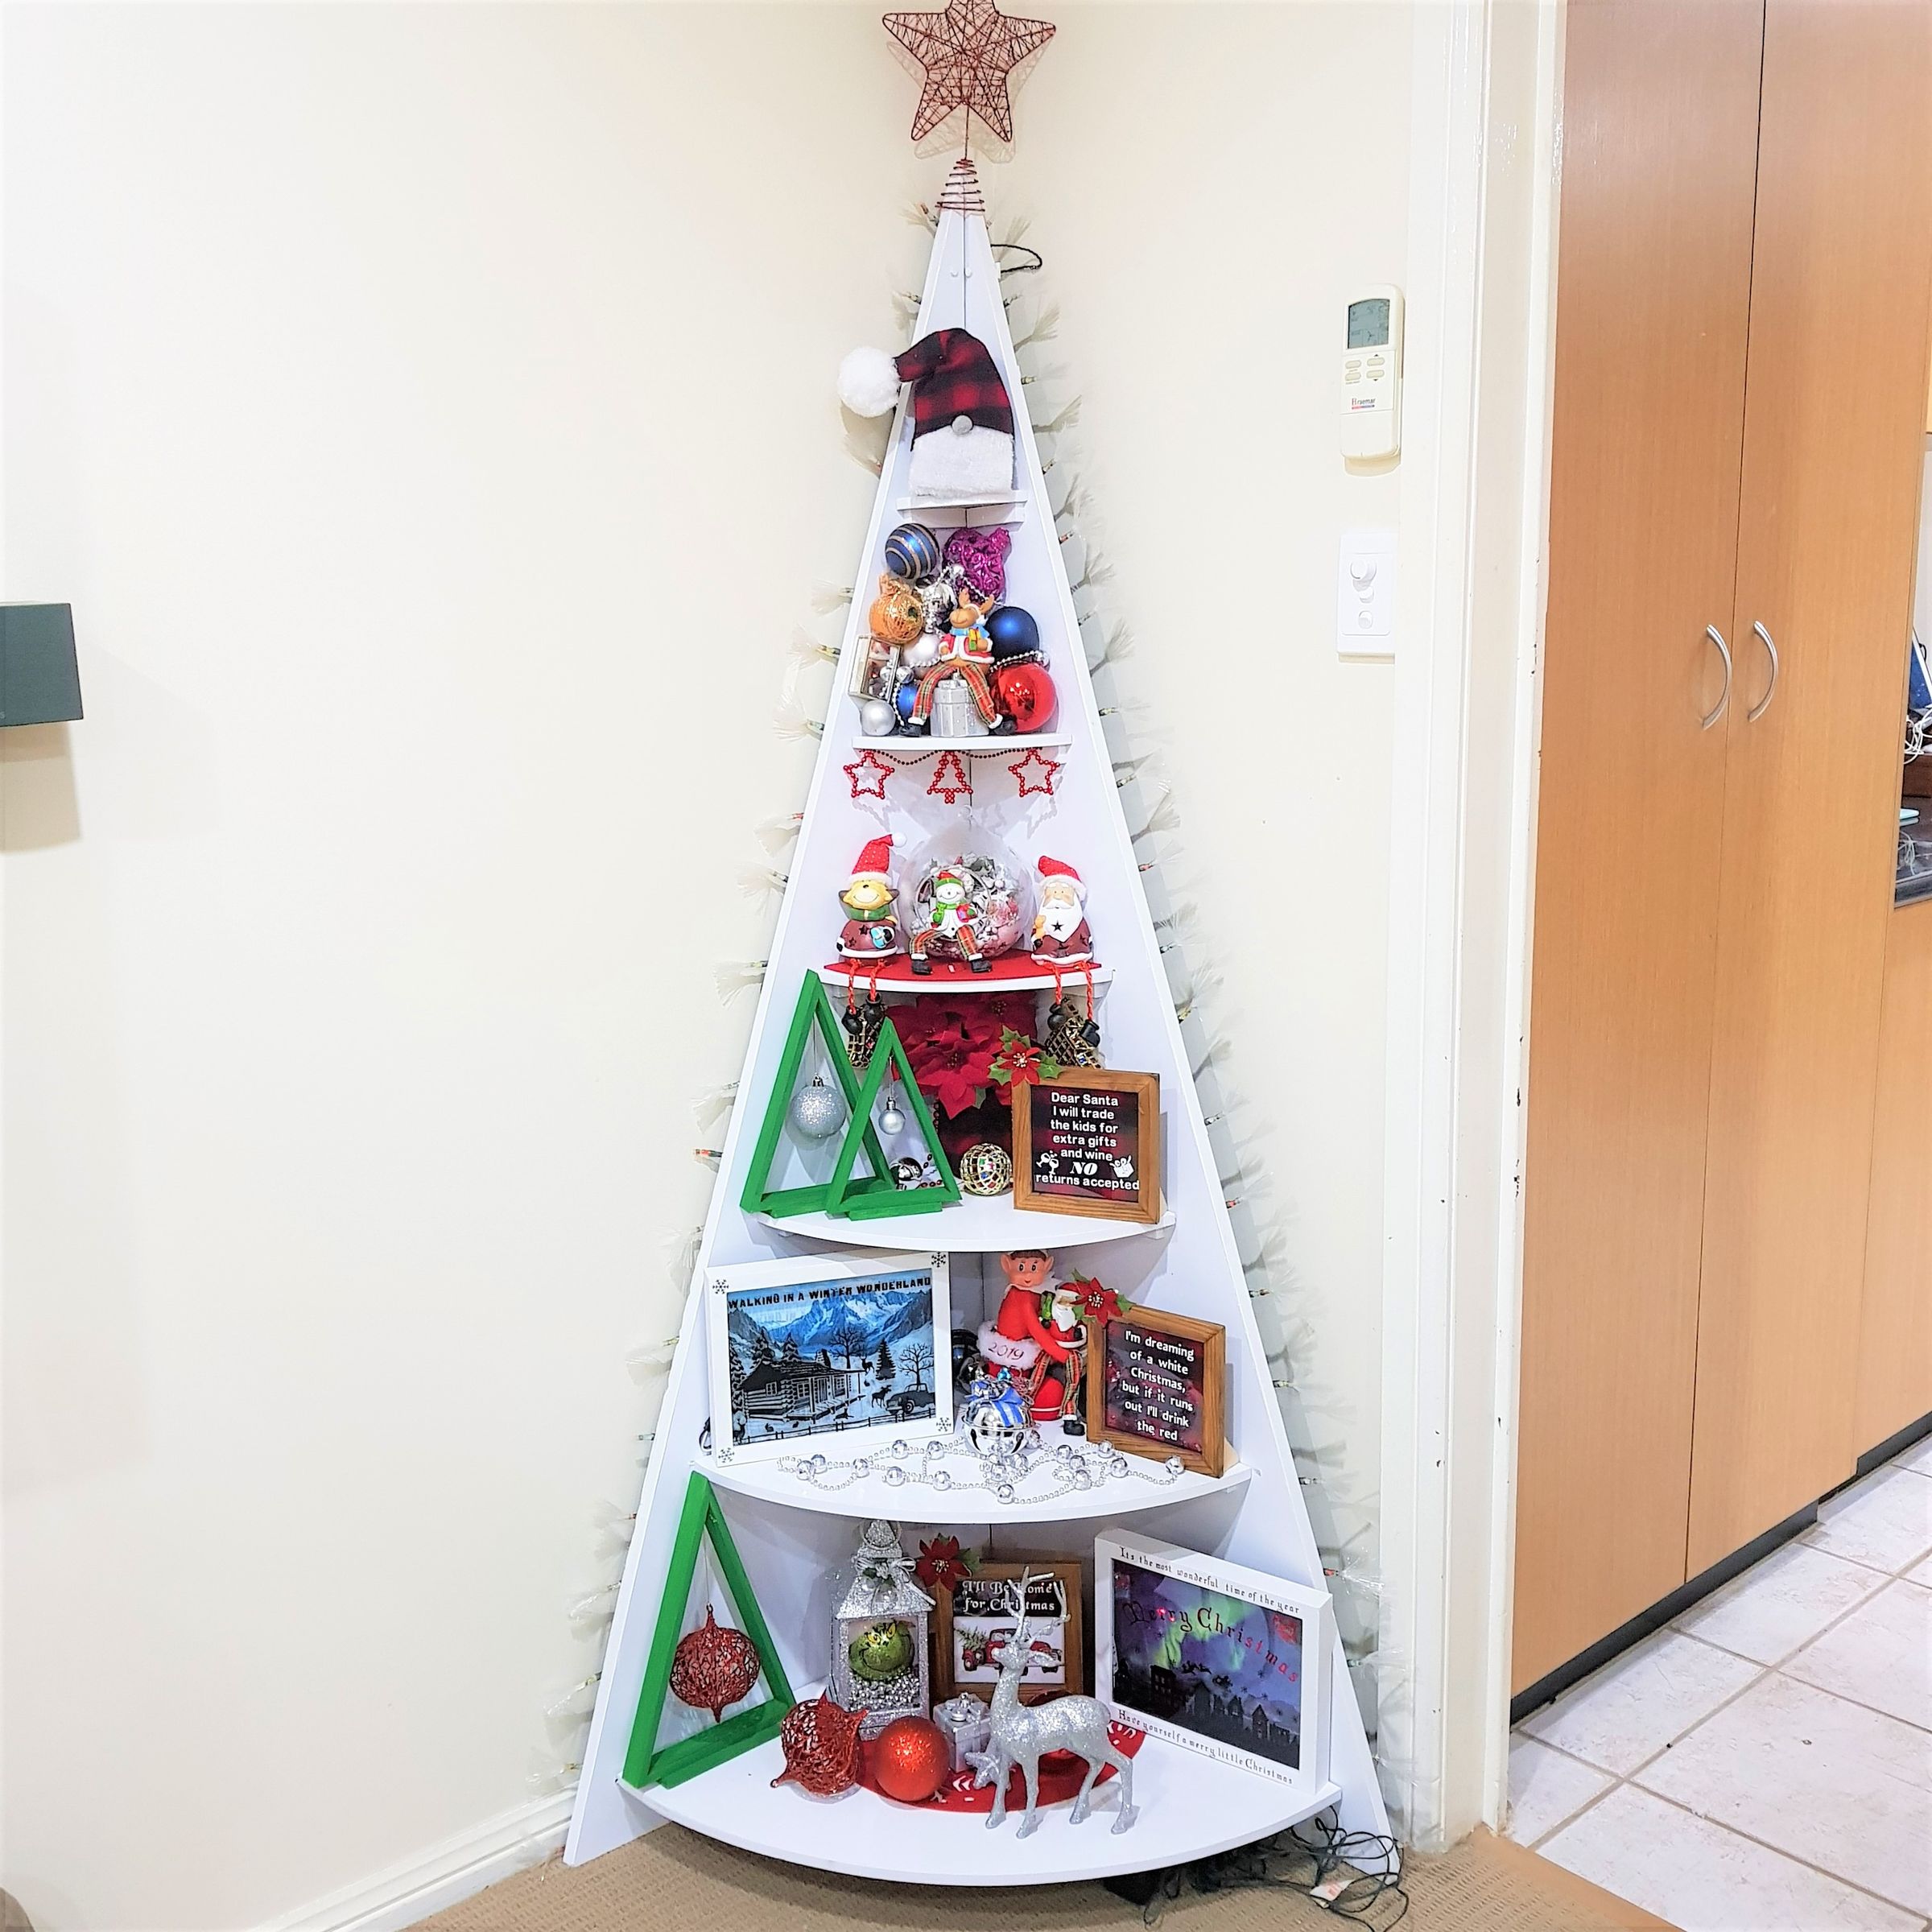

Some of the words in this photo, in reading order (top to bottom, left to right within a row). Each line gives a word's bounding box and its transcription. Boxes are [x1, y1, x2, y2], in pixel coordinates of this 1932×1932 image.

[1051, 1092, 1080, 1104] Dear
[1083, 1095, 1118, 1106] Santa
[1053, 1106, 1056, 1116] I
[1059, 1107, 1079, 1117] will
[1081, 1108, 1114, 1120] trade
[1051, 1120, 1070, 1130] the
[1072, 1121, 1096, 1132] kids
[1100, 1123, 1118, 1133] for
[1053, 1135, 1085, 1145] extra
[1088, 1136, 1117, 1148] gifts
[1060, 1148, 1083, 1159] and
[1085, 1150, 1113, 1161] wine
[1070, 1162, 1098, 1175] NO
[1036, 1174, 1080, 1185] returns
[1083, 1179, 1139, 1191] accepted
[728, 1293, 780, 1309] WALKING
[784, 1293, 795, 1302] IN
[798, 1292, 805, 1302] A
[809, 1286, 852, 1299] WINTER
[856, 1277, 931, 1293] WONDERLAND
[988, 1341, 1025, 1360] 2019
[1125, 1331, 1141, 1344] I'm
[1145, 1336, 1195, 1361] dreaming
[1130, 1351, 1141, 1361] of
[1146, 1356, 1153, 1364] a
[1158, 1360, 1188, 1375] white
[1131, 1368, 1186, 1393] Christmas,
[1122, 1381, 1139, 1395] but
[1145, 1386, 1152, 1398] if
[1157, 1389, 1166, 1402] it
[1170, 1397, 1193, 1411] runs
[1125, 1401, 1142, 1413] out
[1147, 1406, 1158, 1418] I'll
[1162, 1409, 1190, 1427] drink
[1137, 1421, 1155, 1434] the
[1159, 1428, 1178, 1441] red
[962, 1580, 985, 1593] I'll
[989, 1581, 1009, 1594] Be
[1139, 1555, 1153, 1567] the
[1155, 1563, 1172, 1572] most
[1177, 1570, 1219, 1588] wonderful
[1225, 1583, 1245, 1596] time
[1248, 1591, 1257, 1602] of
[1260, 1594, 1274, 1606] the
[1278, 1601, 1299, 1613] year
[963, 1597, 986, 1612] for
[989, 1598, 1055, 1611] Chritmas
[1122, 1600, 1192, 1632] Merry
[1197, 1607, 1298, 1683] Christmas
[1119, 1709, 1141, 1726] Have
[1143, 1722, 1180, 1743] yourself
[1189, 1740, 1216, 1757] merry
[1218, 1747, 1243, 1765] little
[1245, 1758, 1293, 1784] Christmas
